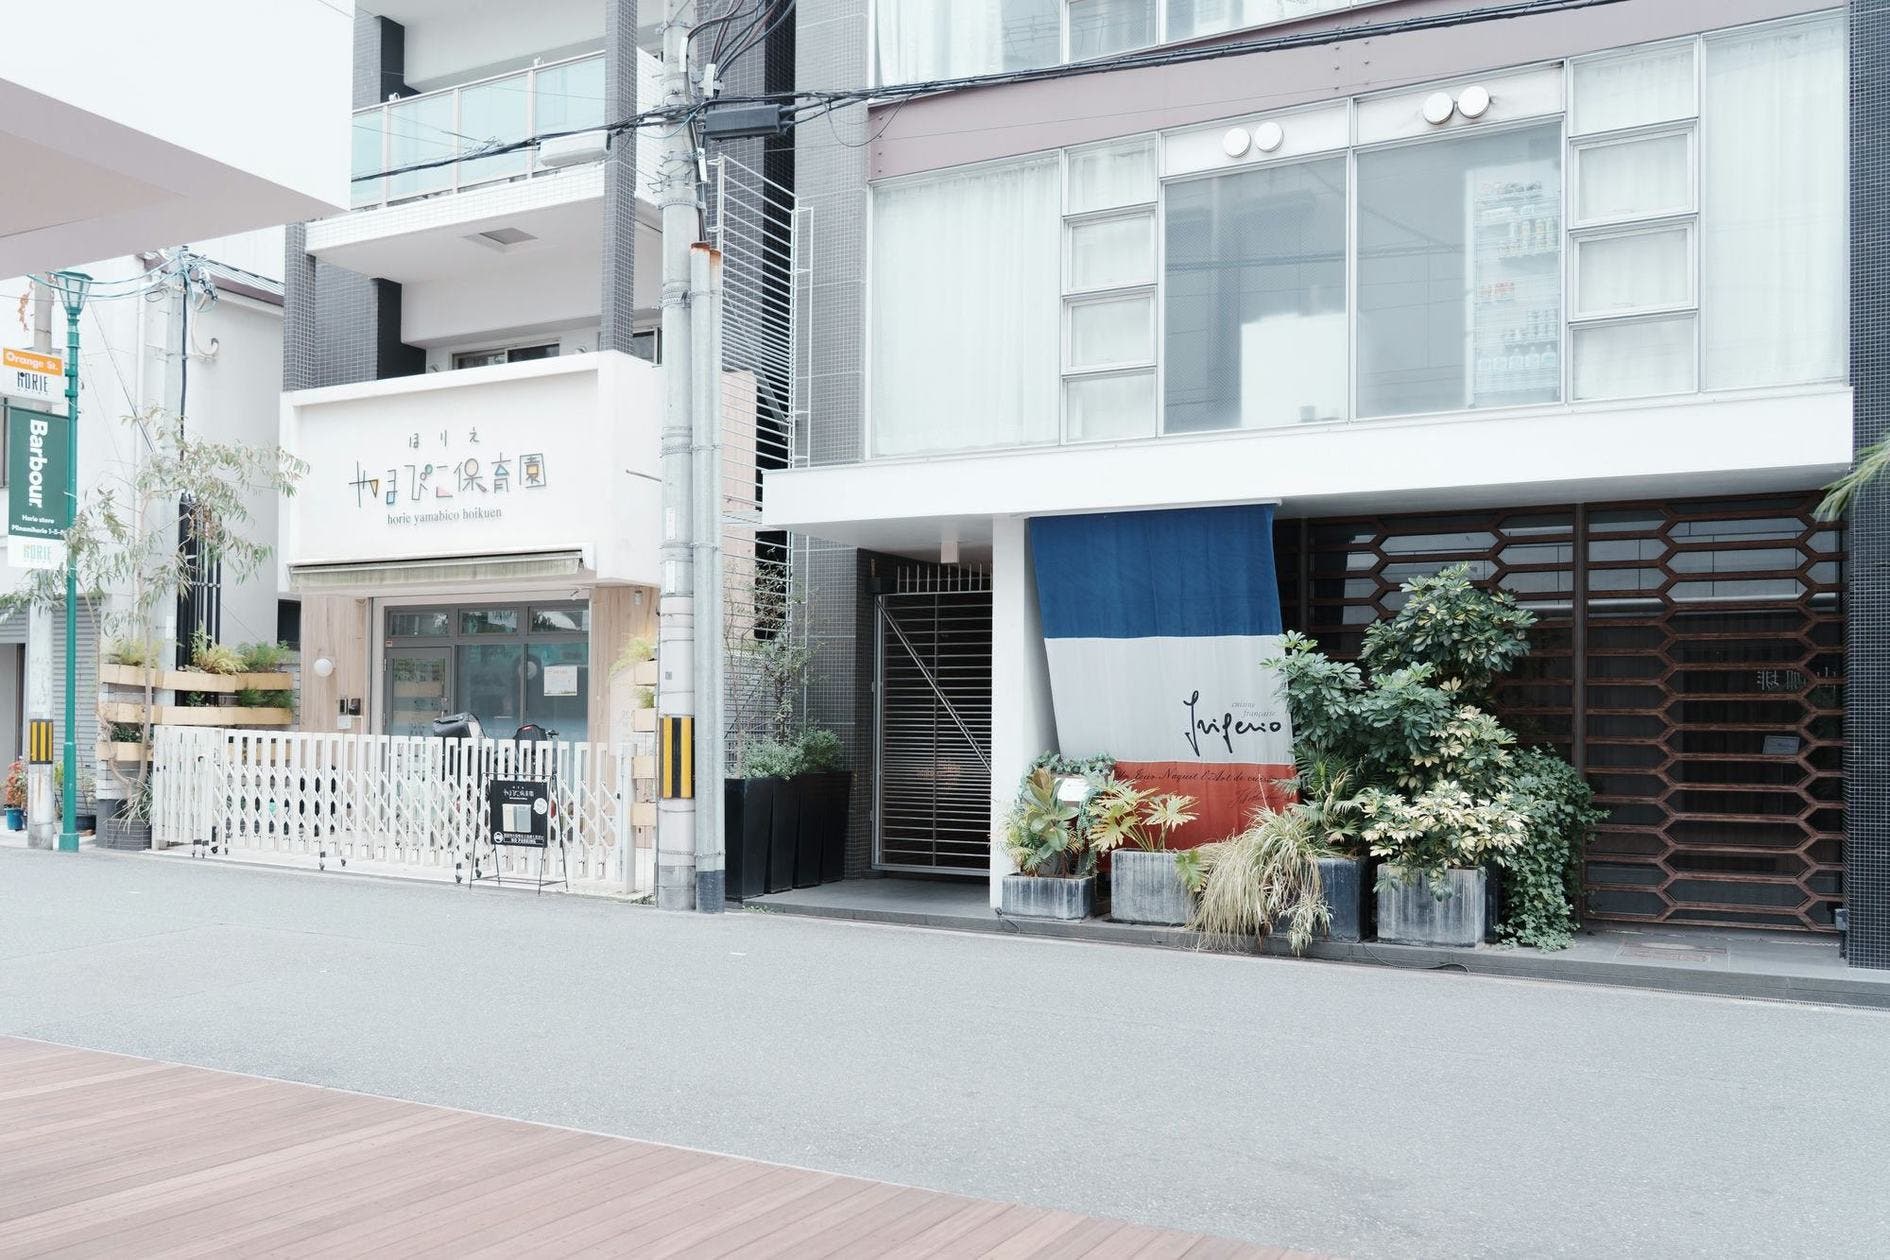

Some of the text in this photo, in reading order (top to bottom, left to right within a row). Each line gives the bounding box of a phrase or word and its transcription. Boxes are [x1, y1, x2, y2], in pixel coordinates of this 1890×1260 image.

[6, 351, 44, 369] Orange
[409, 426, 480, 449] ほりえ
[29, 419, 48, 508] Barbour
[22, 514, 38, 522] Horie
[387, 507, 502, 526] horie yamabico hoikuen
